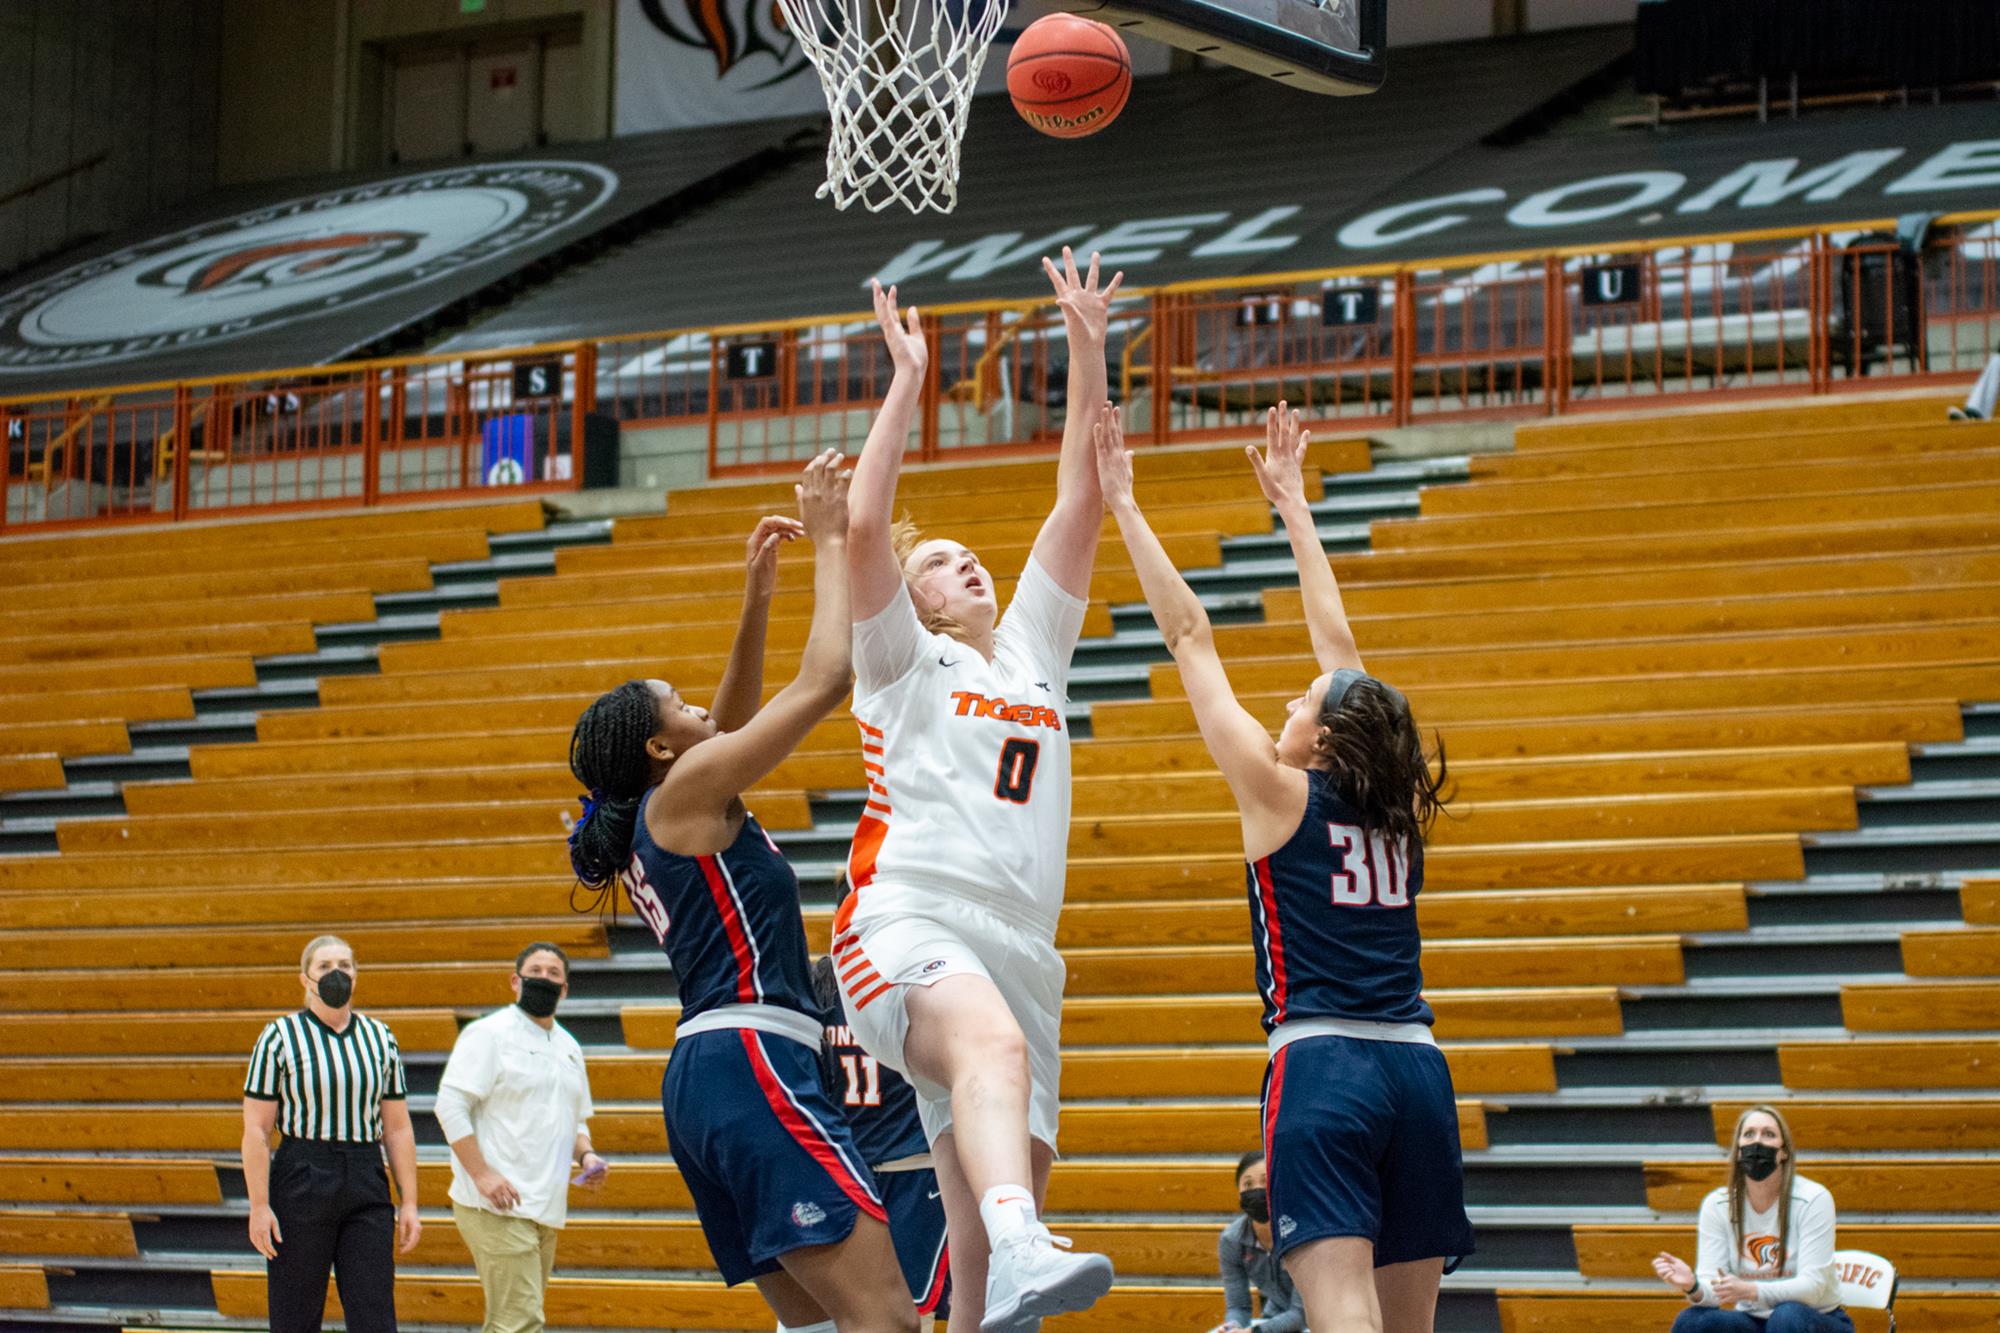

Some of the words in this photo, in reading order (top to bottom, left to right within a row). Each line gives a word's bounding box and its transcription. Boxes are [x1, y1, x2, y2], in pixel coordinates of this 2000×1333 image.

[862, 138, 2000, 289] WELCOME
[1599, 269, 1622, 300] U
[1340, 292, 1363, 321] T
[529, 367, 547, 394] S
[741, 347, 763, 376] T
[993, 736, 1040, 805] 0
[1327, 821, 1411, 908] 30
[839, 1054, 881, 1106] 11
